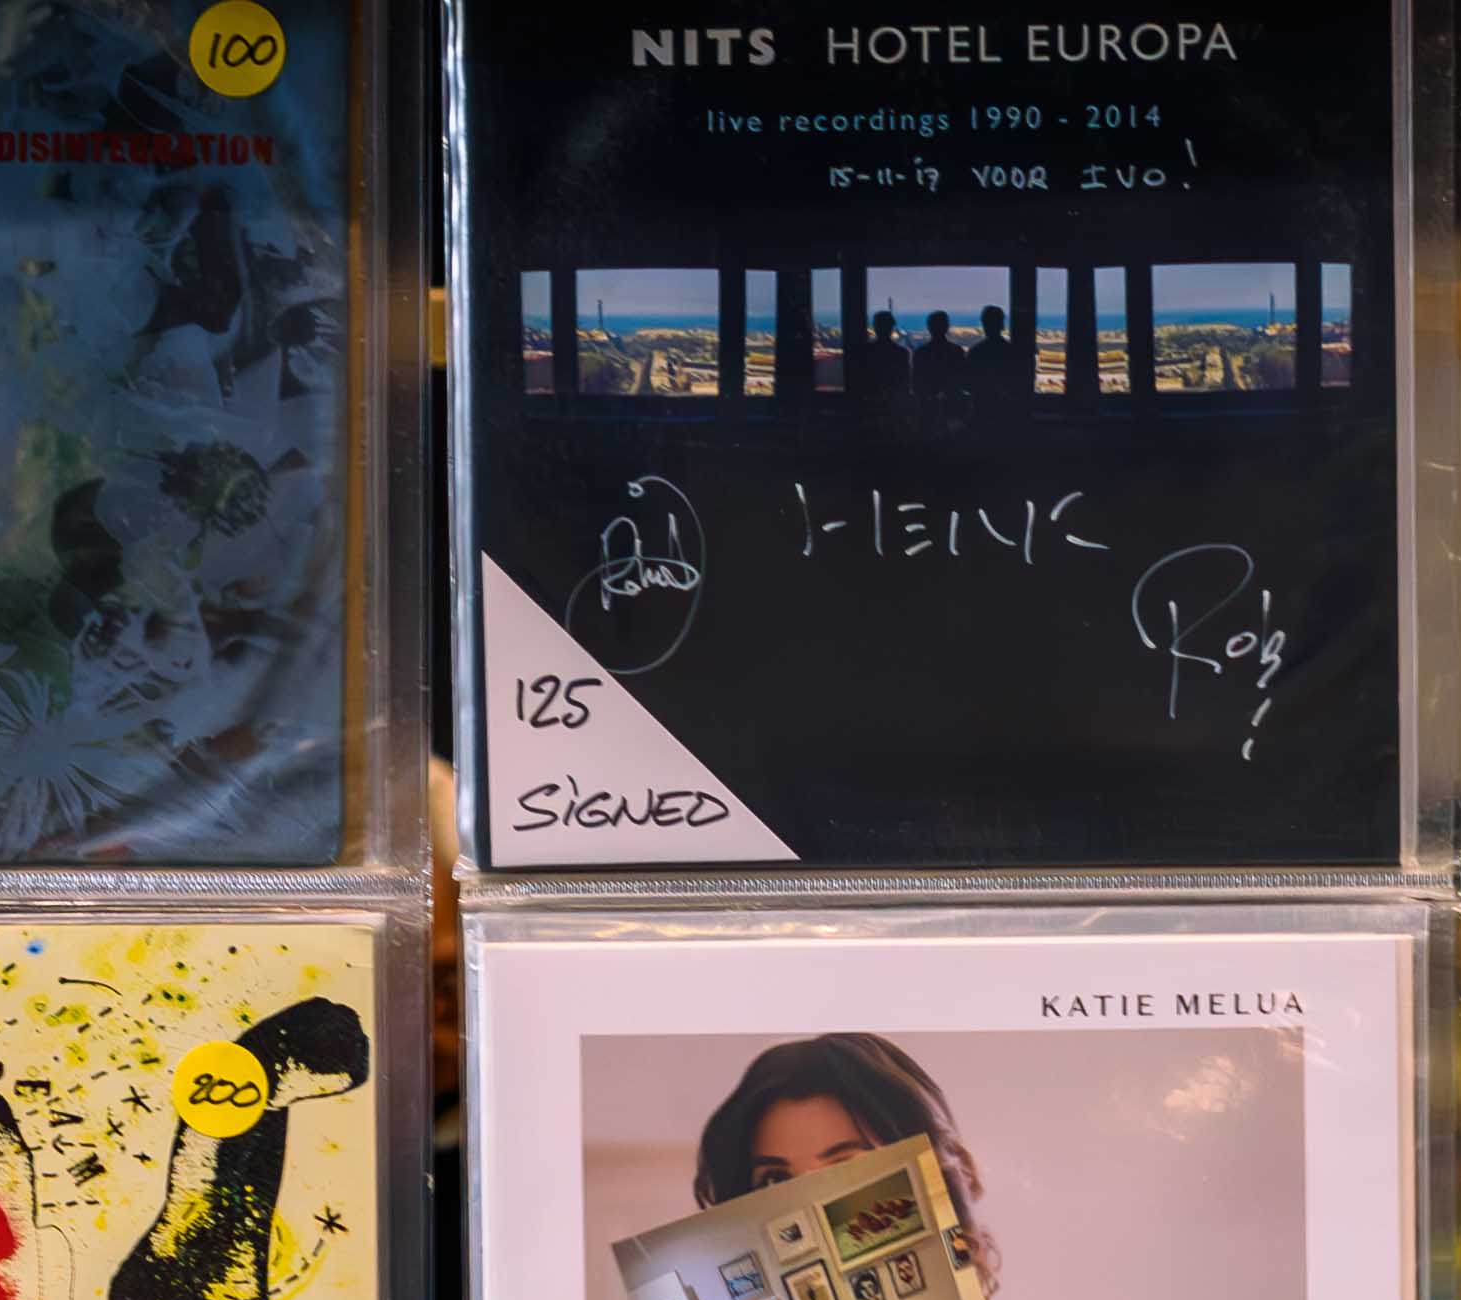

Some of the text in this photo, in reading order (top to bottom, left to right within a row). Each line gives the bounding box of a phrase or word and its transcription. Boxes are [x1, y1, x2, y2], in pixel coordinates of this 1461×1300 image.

[208, 32, 278, 68] 100
[631, 21, 1238, 67] NITS HOTEL EUROPA
[706, 103, 1163, 138] live recordings 1990 2014
[514, 675, 603, 730] 125
[1040, 991, 1306, 1019] KATIE MELUA
[186, 1072, 262, 1109] 200
